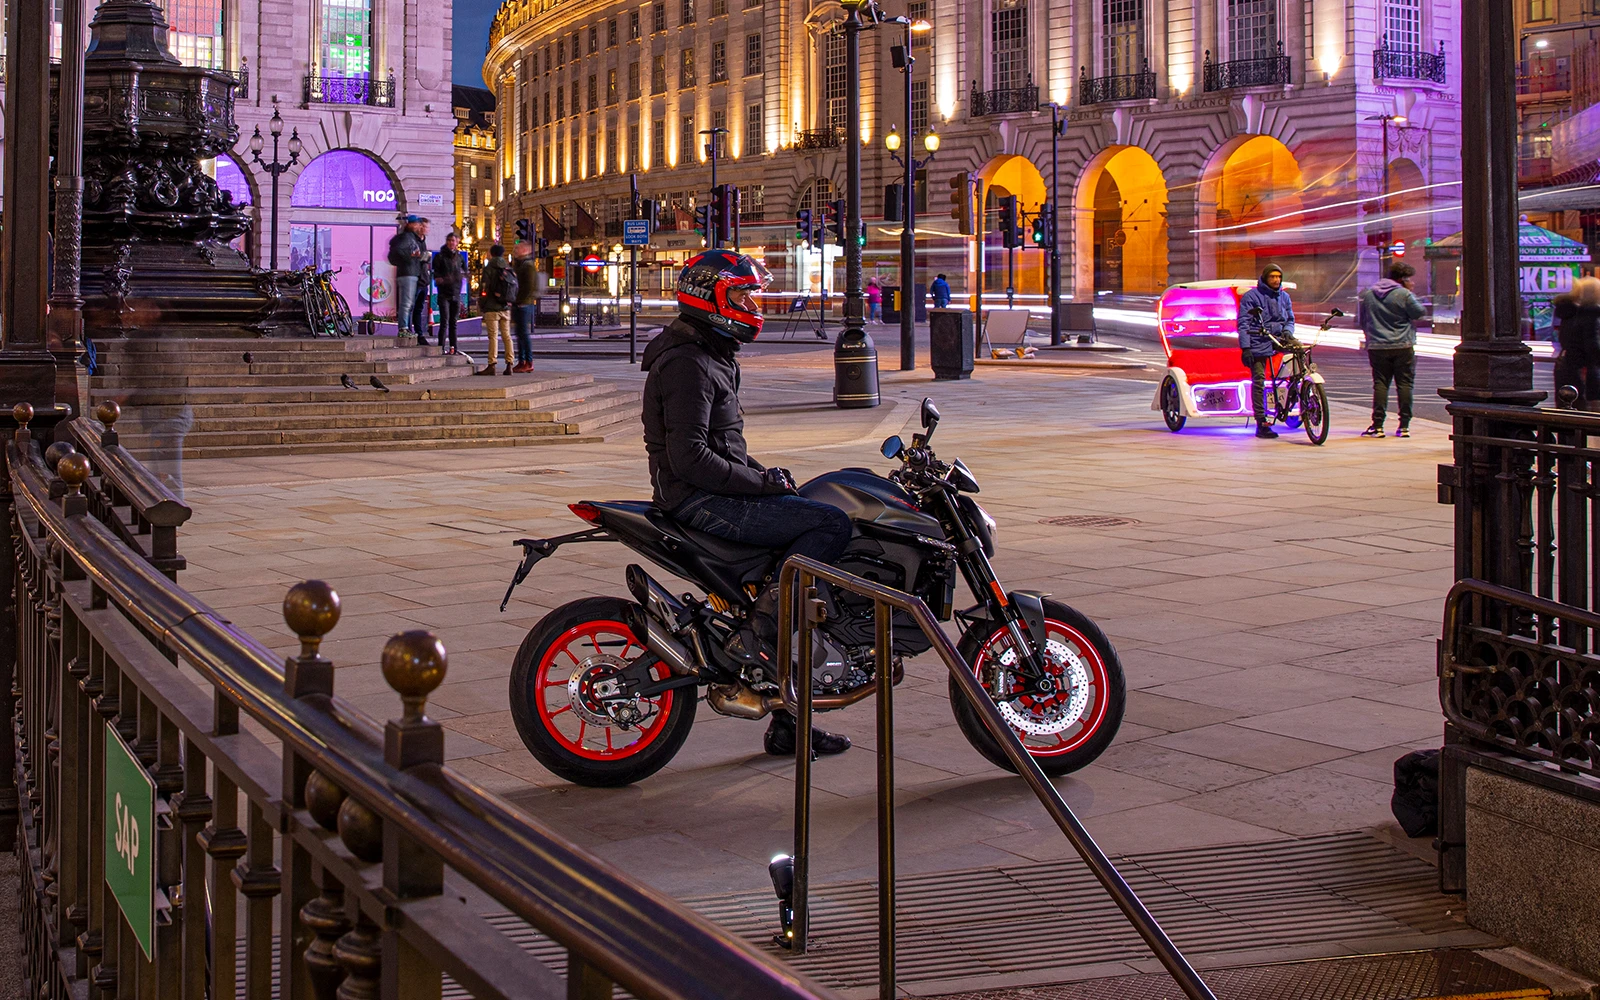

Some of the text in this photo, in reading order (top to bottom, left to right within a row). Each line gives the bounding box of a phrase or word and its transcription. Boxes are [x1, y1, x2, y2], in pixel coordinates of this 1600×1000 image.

[1128, 105, 1151, 115] FIRE
[1174, 96, 1230, 110] ALLIANCE
[1259, 92, 1286, 101] LIFE
[1519, 236, 1551, 245] KED
[1519, 267, 1573, 293] KED
[115, 791, 140, 876] SAP
